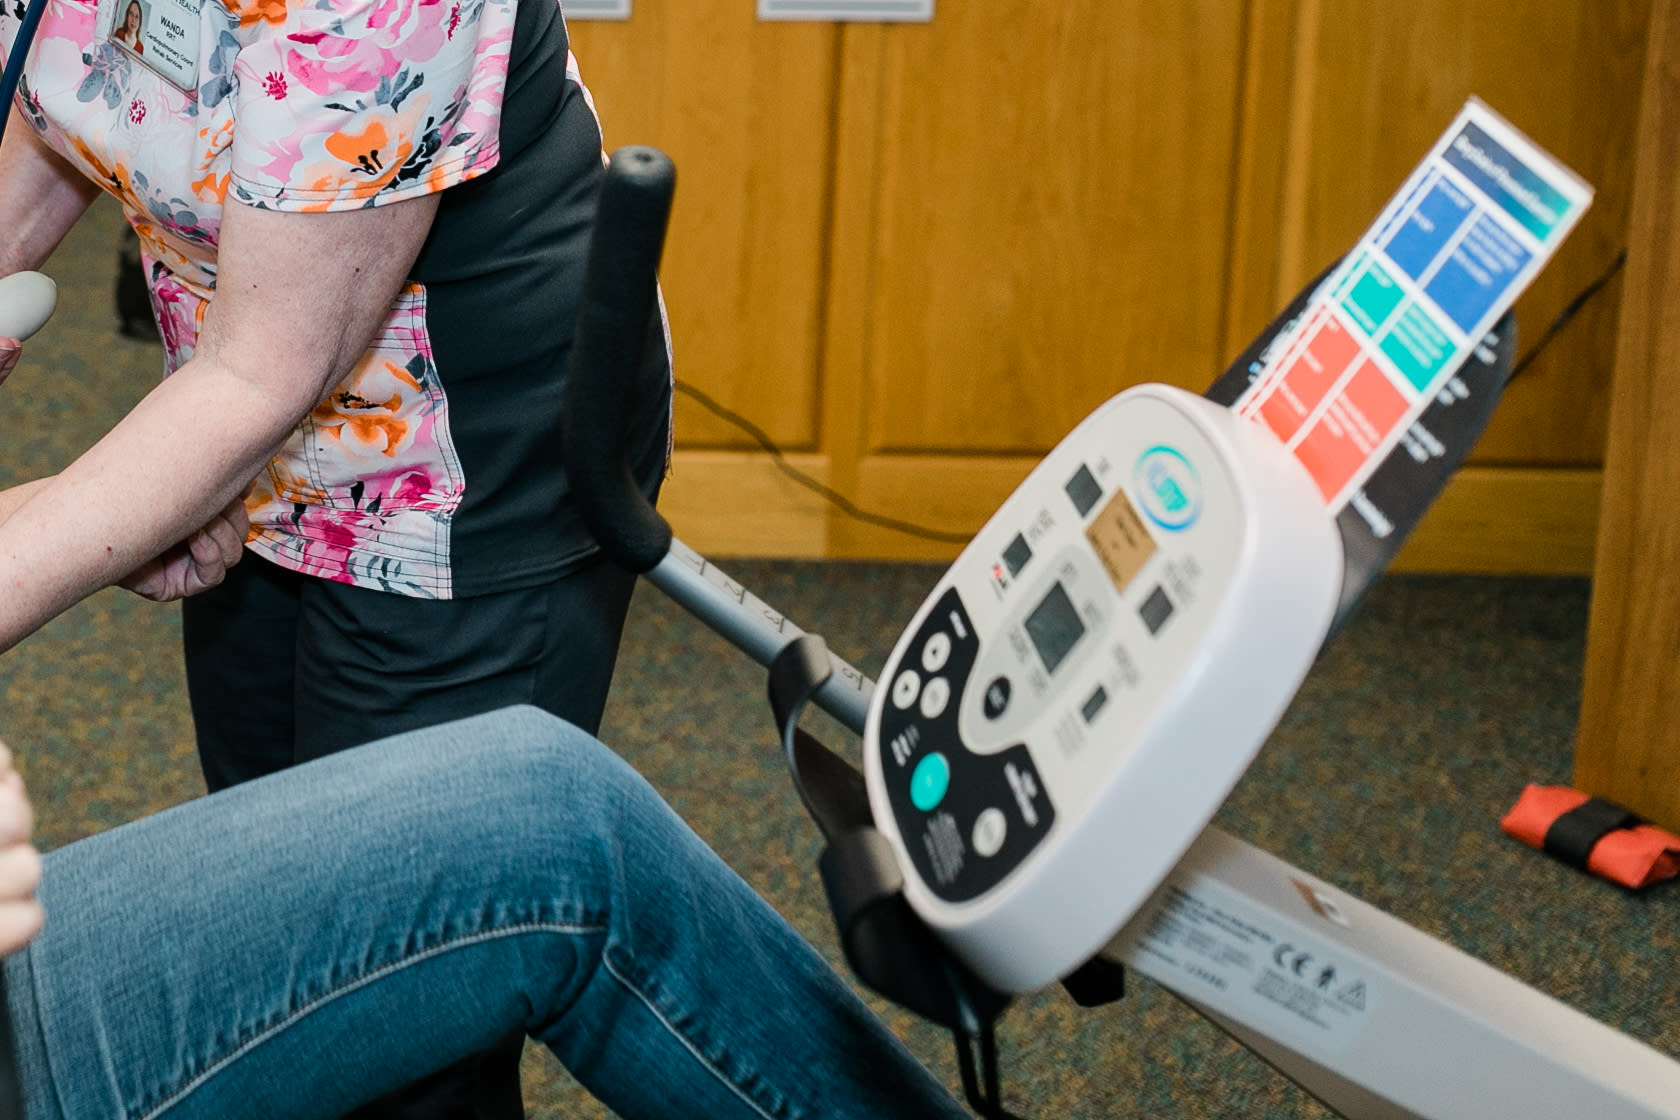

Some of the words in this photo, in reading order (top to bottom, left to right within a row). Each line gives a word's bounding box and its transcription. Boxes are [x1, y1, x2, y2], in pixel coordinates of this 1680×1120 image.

[160, 15, 185, 38] WANDA
[723, 581, 741, 596] 2
[763, 609, 780, 625] 3
[842, 666, 859, 683] 5
